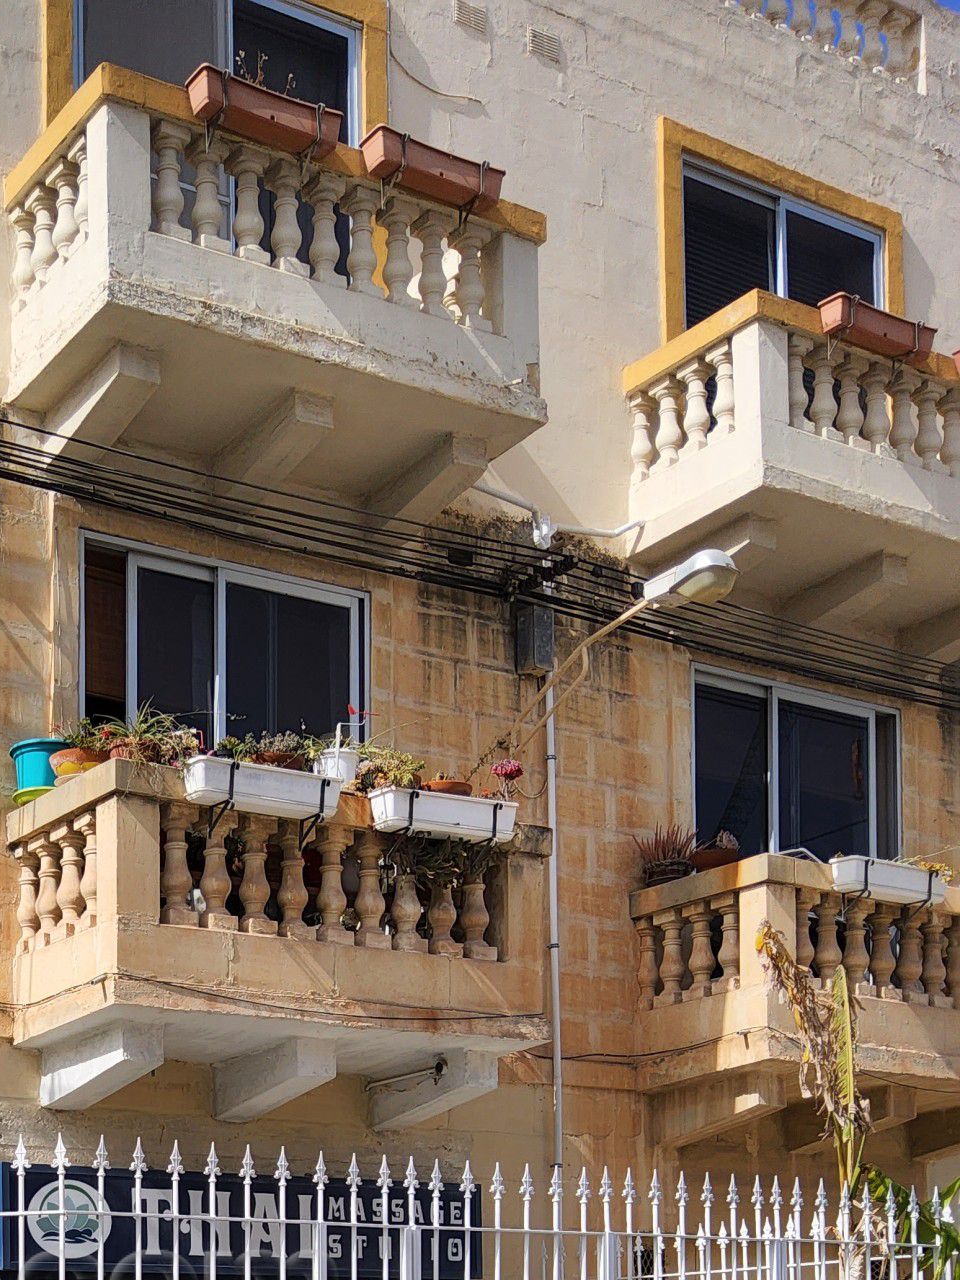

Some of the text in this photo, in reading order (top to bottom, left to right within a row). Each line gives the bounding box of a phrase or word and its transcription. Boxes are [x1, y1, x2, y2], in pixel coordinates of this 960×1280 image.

[131, 1187, 316, 1259] THAI
[327, 1196, 463, 1226] MASSAGE
[328, 1234, 463, 1263] STUIO
